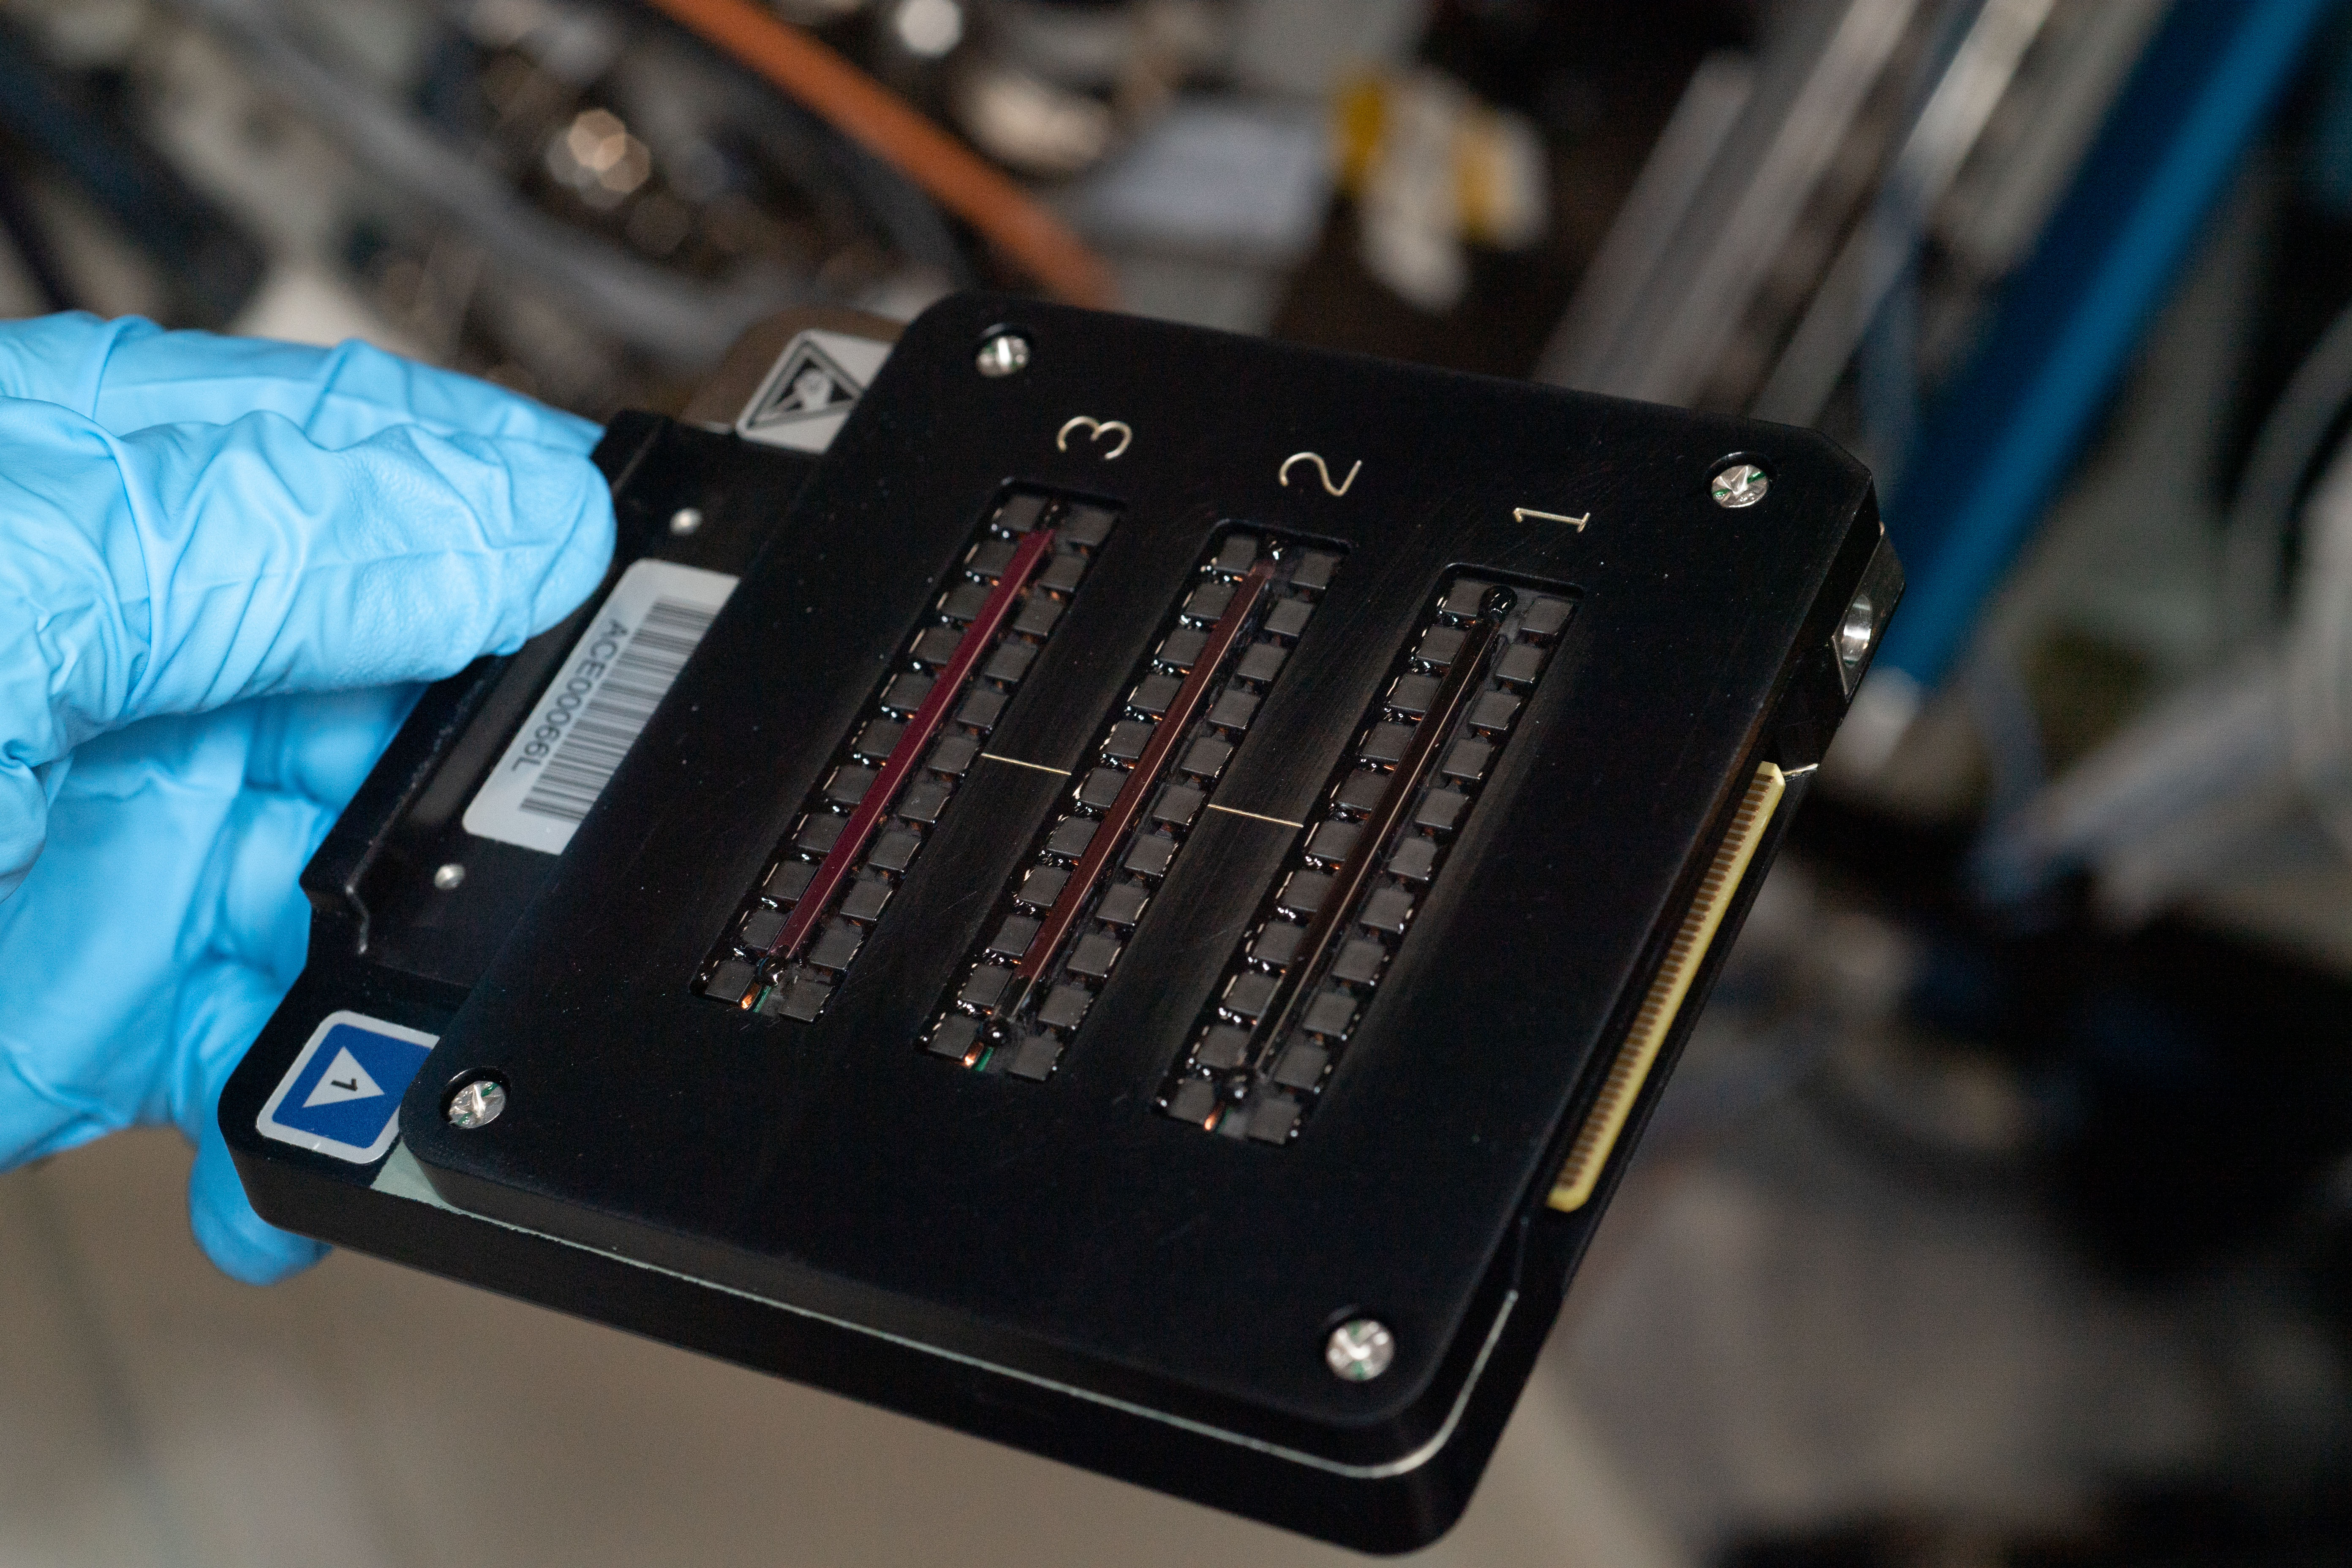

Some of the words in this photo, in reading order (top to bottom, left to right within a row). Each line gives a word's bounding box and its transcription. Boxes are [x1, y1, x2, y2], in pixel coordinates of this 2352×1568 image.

[1057, 416, 1132, 460] 3
[1279, 451, 1362, 497] 2
[1512, 507, 1591, 533] 1
[331, 1078, 358, 1092] 1
